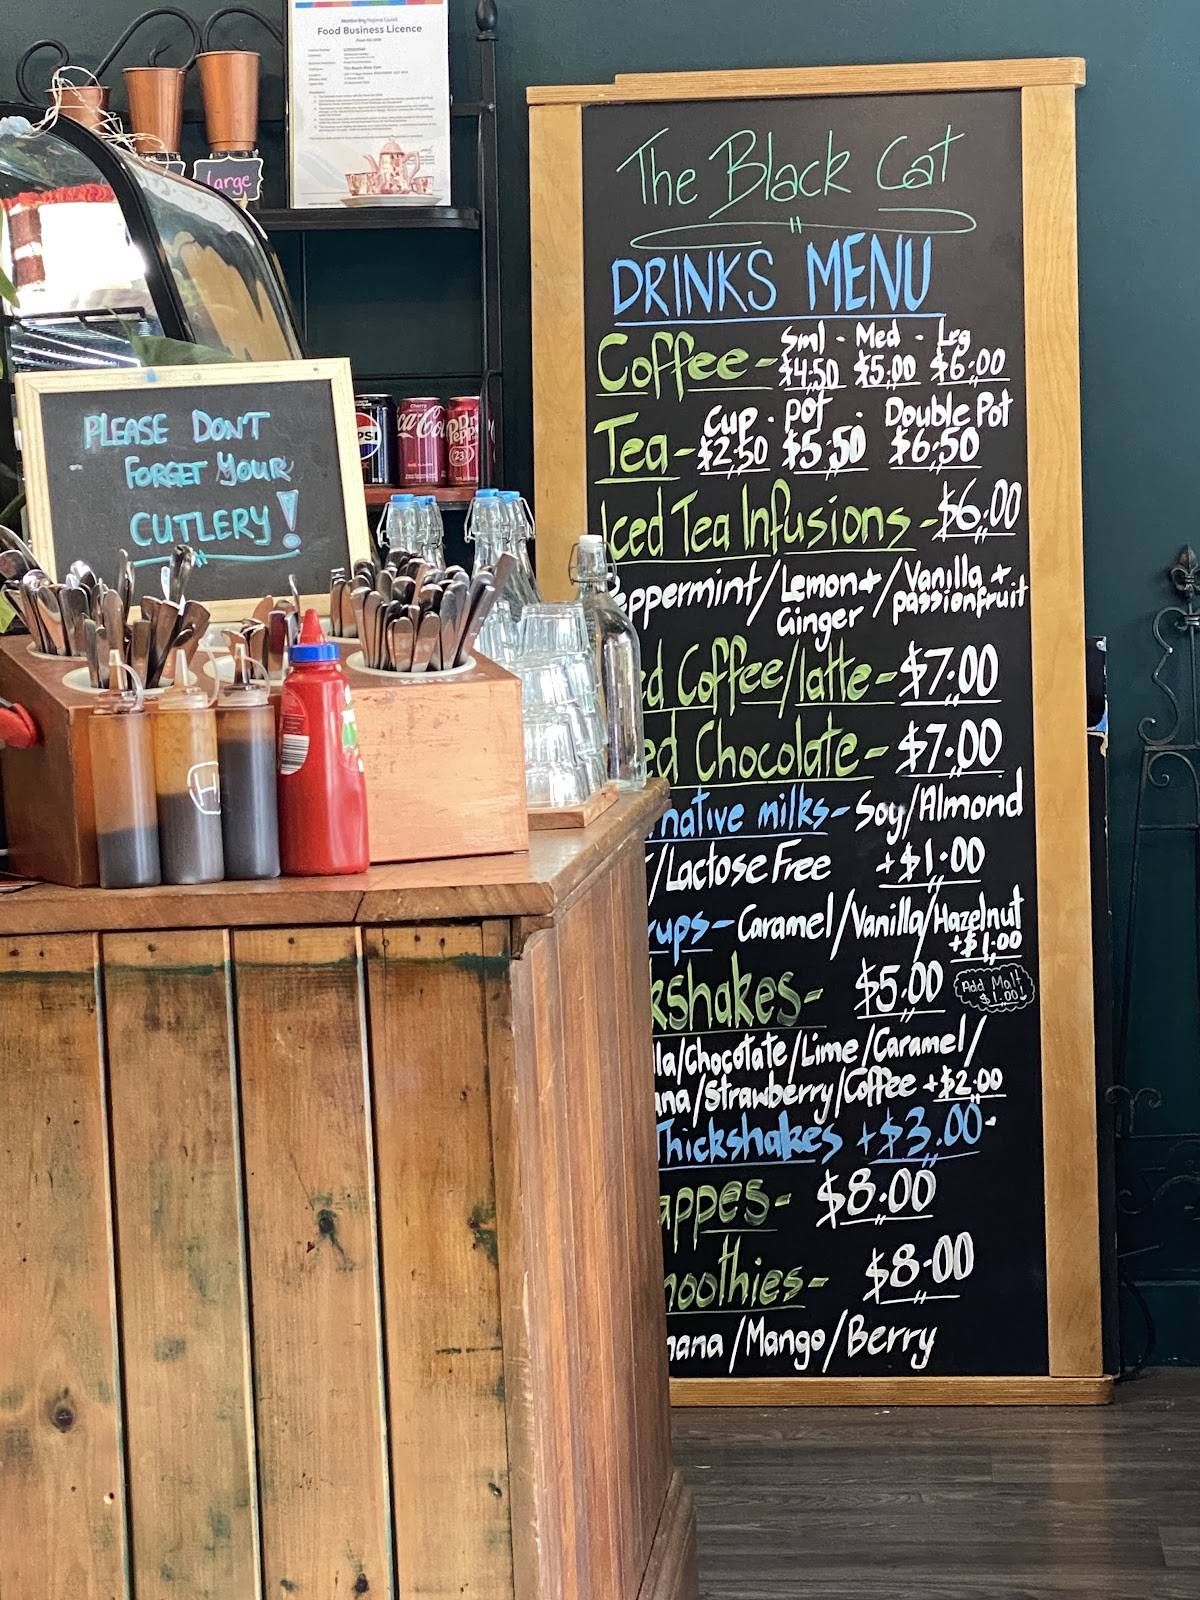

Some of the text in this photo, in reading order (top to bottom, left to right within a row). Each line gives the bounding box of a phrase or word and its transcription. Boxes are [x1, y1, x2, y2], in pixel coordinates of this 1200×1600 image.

[317, 24, 422, 36] Food Business Licence
[616, 124, 966, 219] The Black Cat
[612, 231, 932, 316] DRINKS MENU
[780, 320, 825, 352] Sml
[856, 318, 900, 349] Med
[936, 317, 971, 352] Lrg
[778, 352, 840, 389] $4.50
[853, 350, 917, 386] $5.00
[930, 347, 1006, 383] $6.00
[83, 411, 169, 449] PLEASE
[885, 391, 970, 428] Double
[977, 389, 1014, 428] Pot
[124, 455, 208, 489] FORGET
[454, 450, 465, 461] 23
[697, 435, 769, 475] $2.50
[782, 425, 867, 470] $5.50
[888, 425, 980, 466] $6.50
[601, 486, 663, 560] Iced
[670, 489, 730, 557] Tea
[931, 478, 1022, 542] $6.00
[893, 574, 1029, 626] passionfruit
[776, 606, 864, 652] Ginger
[898, 640, 999, 700] $7.00
[895, 718, 1003, 774] $7.00
[649, 783, 745, 839] native
[772, 838, 831, 884] Free
[854, 957, 944, 1016] $5.00
[962, 969, 1021, 992] Add Malt
[816, 1167, 937, 1229] $8.00
[863, 1231, 974, 1305] $8.00
